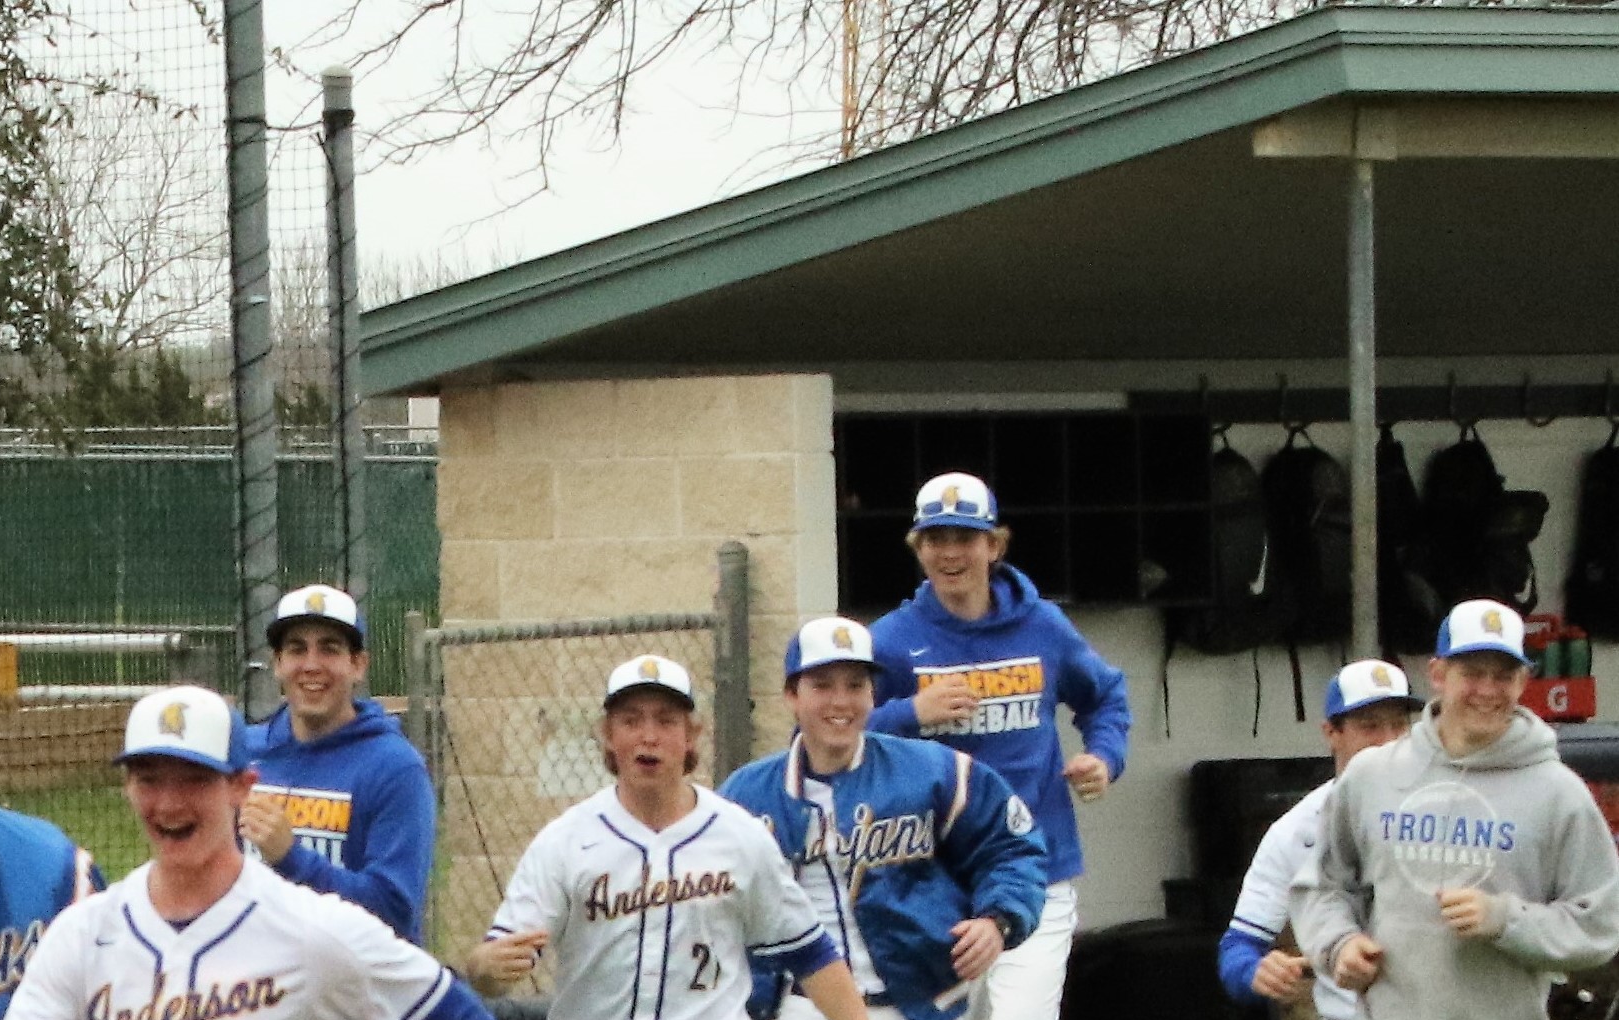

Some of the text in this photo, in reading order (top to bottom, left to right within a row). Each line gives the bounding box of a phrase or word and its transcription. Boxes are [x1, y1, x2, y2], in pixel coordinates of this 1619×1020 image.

[917, 664, 1043, 700] ERSON
[1546, 685, 1569, 713] G
[919, 699, 1041, 738] SEBALL
[584, 862, 736, 922] Anderson
